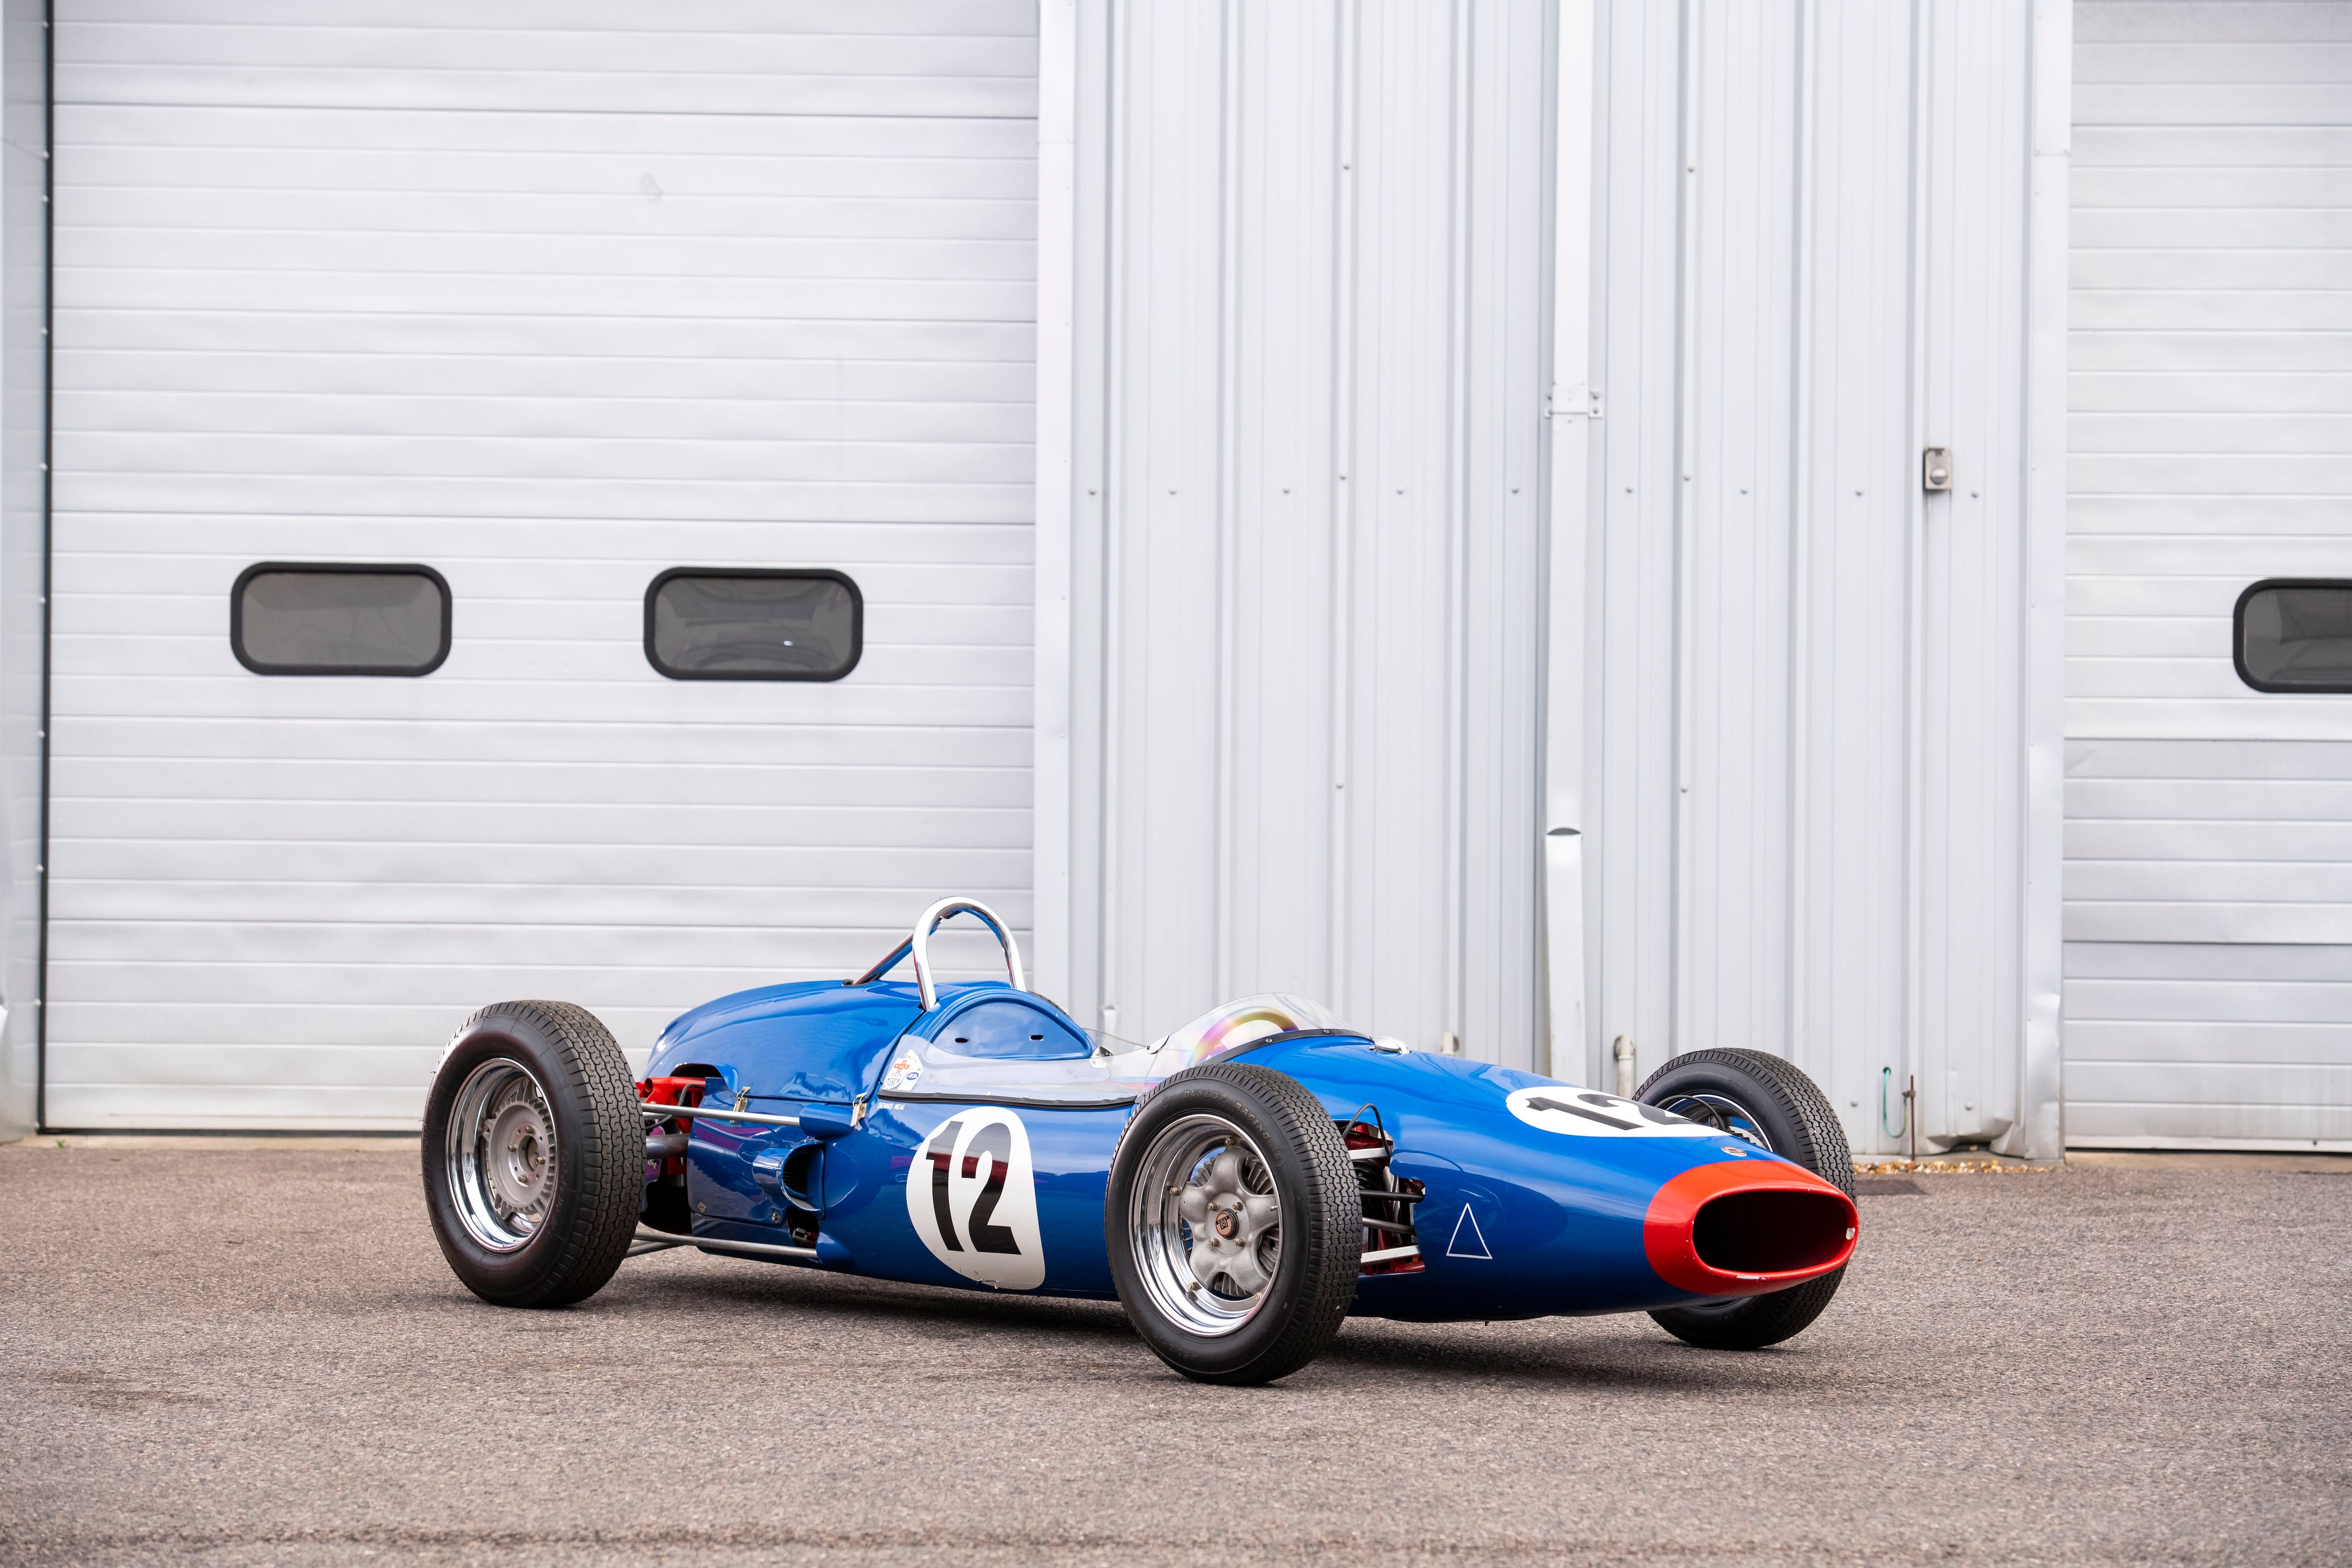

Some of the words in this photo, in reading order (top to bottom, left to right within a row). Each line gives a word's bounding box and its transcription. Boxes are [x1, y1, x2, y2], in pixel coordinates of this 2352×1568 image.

[1183, 1090, 1227, 1101] DUNLOP
[1236, 1102, 1271, 1140] RACING
[1525, 1094, 1702, 1130] 12
[926, 1121, 1022, 1255] 12
